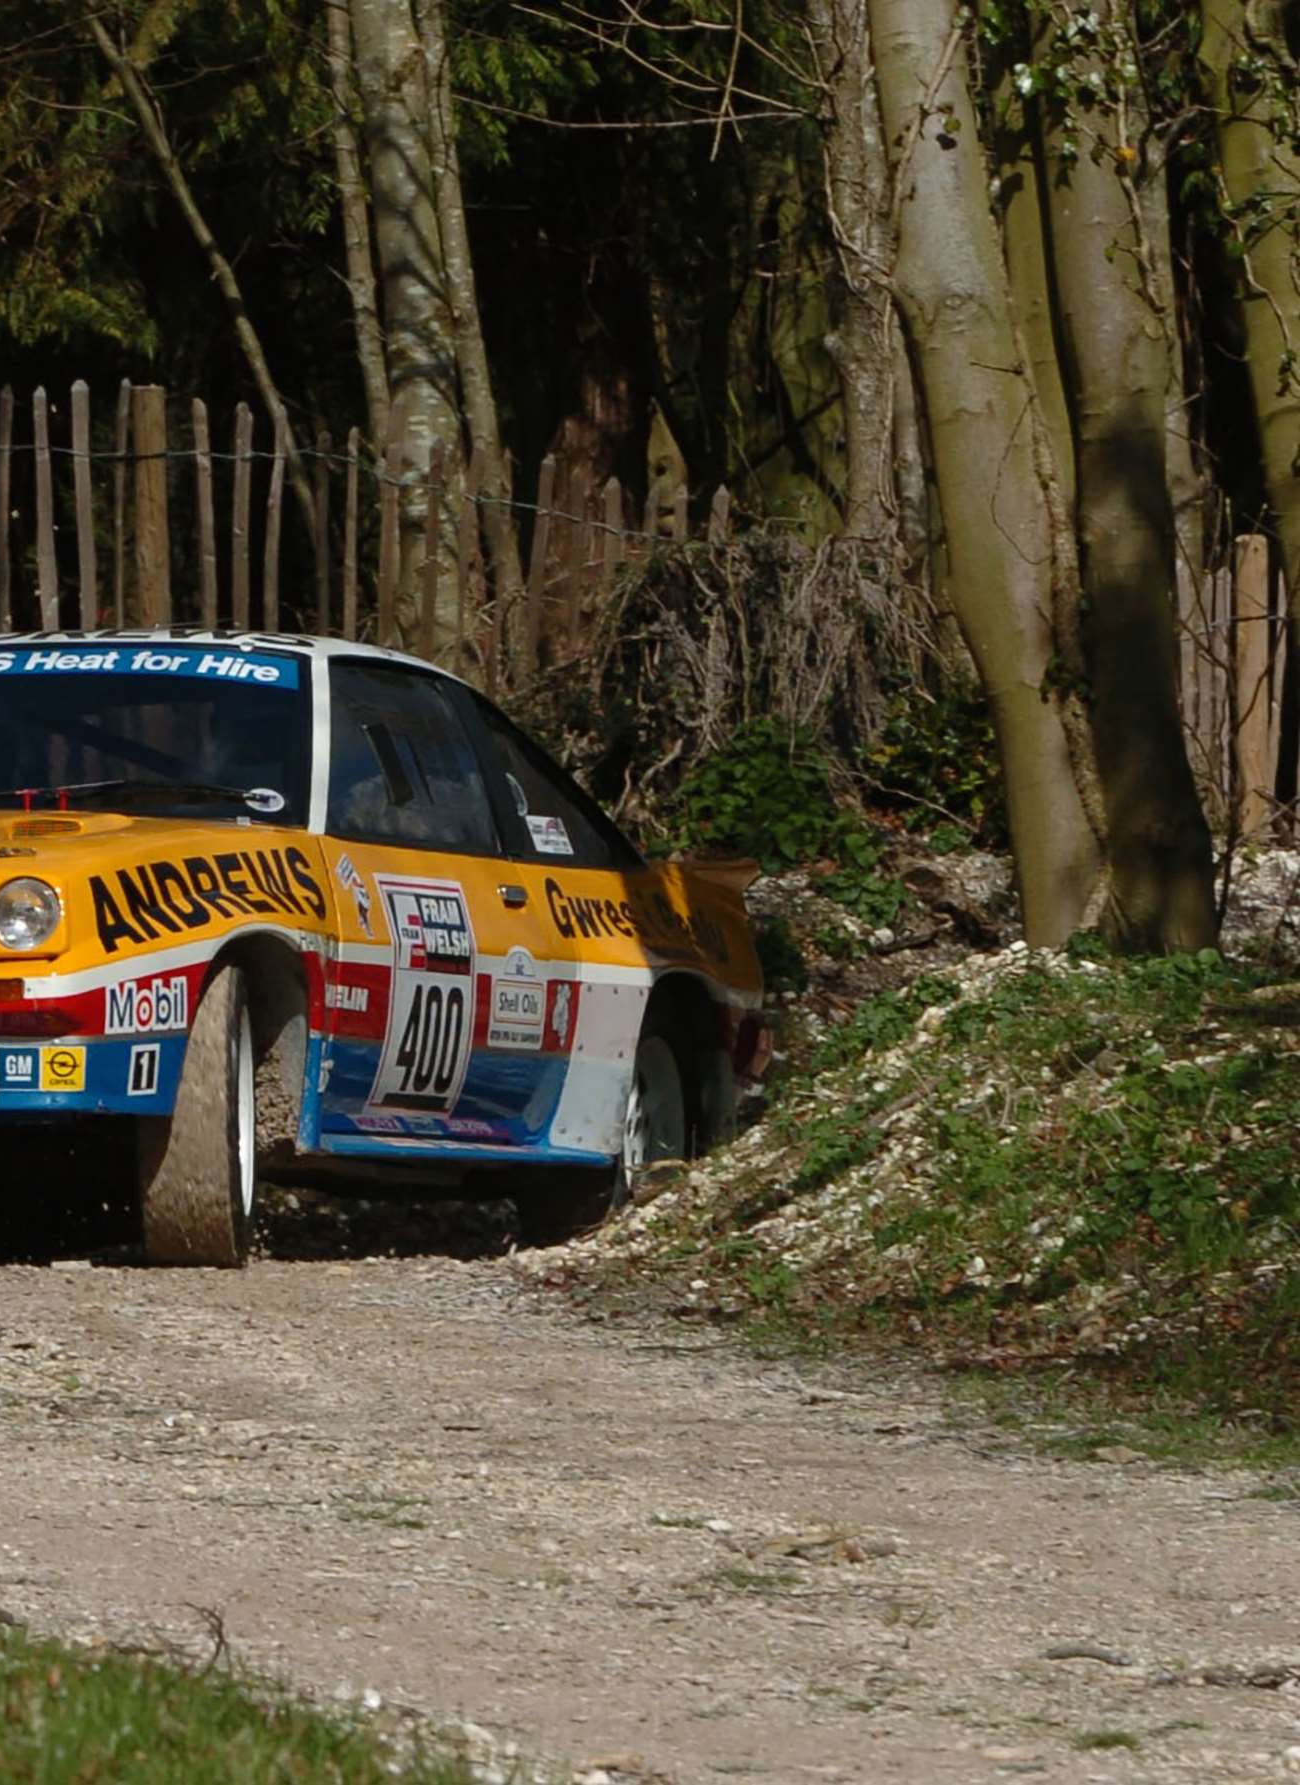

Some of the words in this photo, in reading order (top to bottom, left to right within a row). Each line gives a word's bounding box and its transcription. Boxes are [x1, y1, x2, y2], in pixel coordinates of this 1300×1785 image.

[24, 651, 120, 671] Heat
[131, 650, 188, 671] for
[197, 654, 280, 682] Hire
[88, 847, 327, 953] ANDREWS
[420, 897, 462, 926] FRAM
[423, 928, 470, 957] WELSH
[108, 981, 185, 1029] Mobil
[499, 991, 519, 1013] Shell
[396, 984, 464, 1094] 400
[5, 1055, 33, 1075] GM
